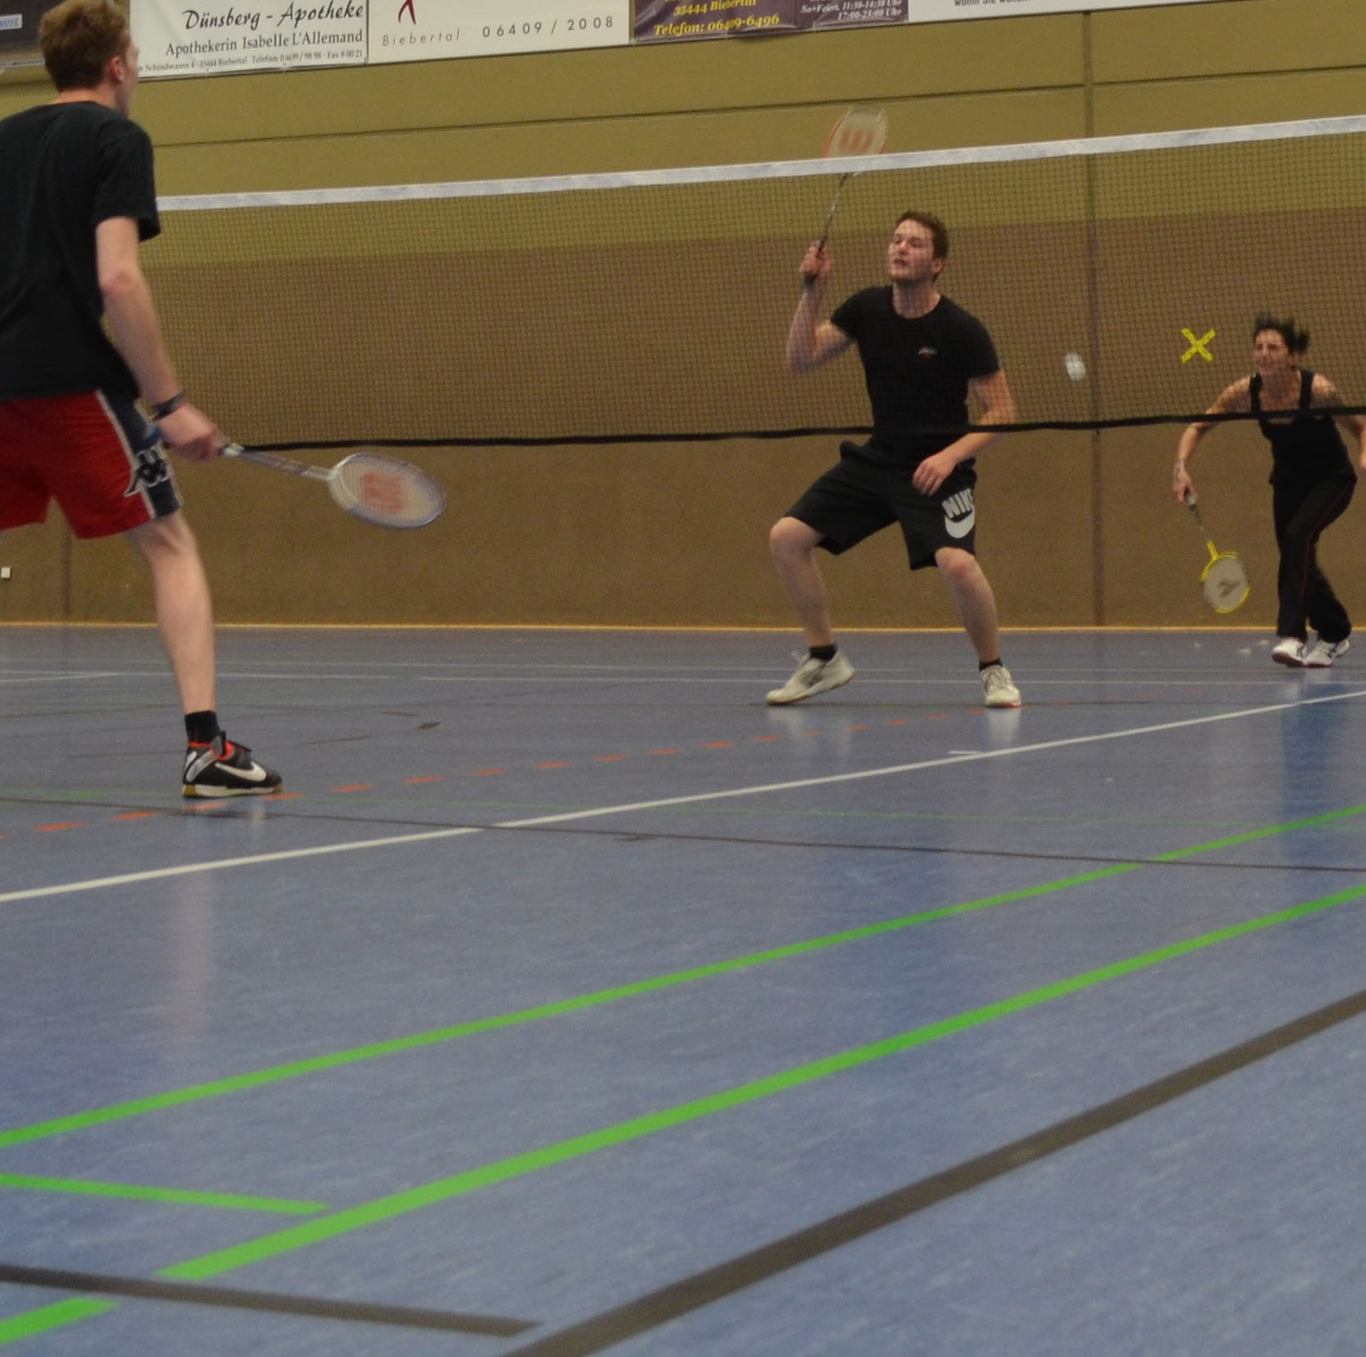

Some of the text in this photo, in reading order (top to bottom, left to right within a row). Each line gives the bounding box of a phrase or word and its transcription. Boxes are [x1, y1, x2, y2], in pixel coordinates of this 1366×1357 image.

[182, 7, 260, 30] Dünsberg
[276, 0, 363, 28] Apotheke
[674, 5, 707, 16] 35444
[382, 16, 614, 46] Biebertal 06409 / 2008
[654, 14, 780, 36] Telefon: 06409-6496
[166, 29, 363, 58] Apothekerin Isabelle L'Allemand
[253, 54, 278, 64] Telefon
